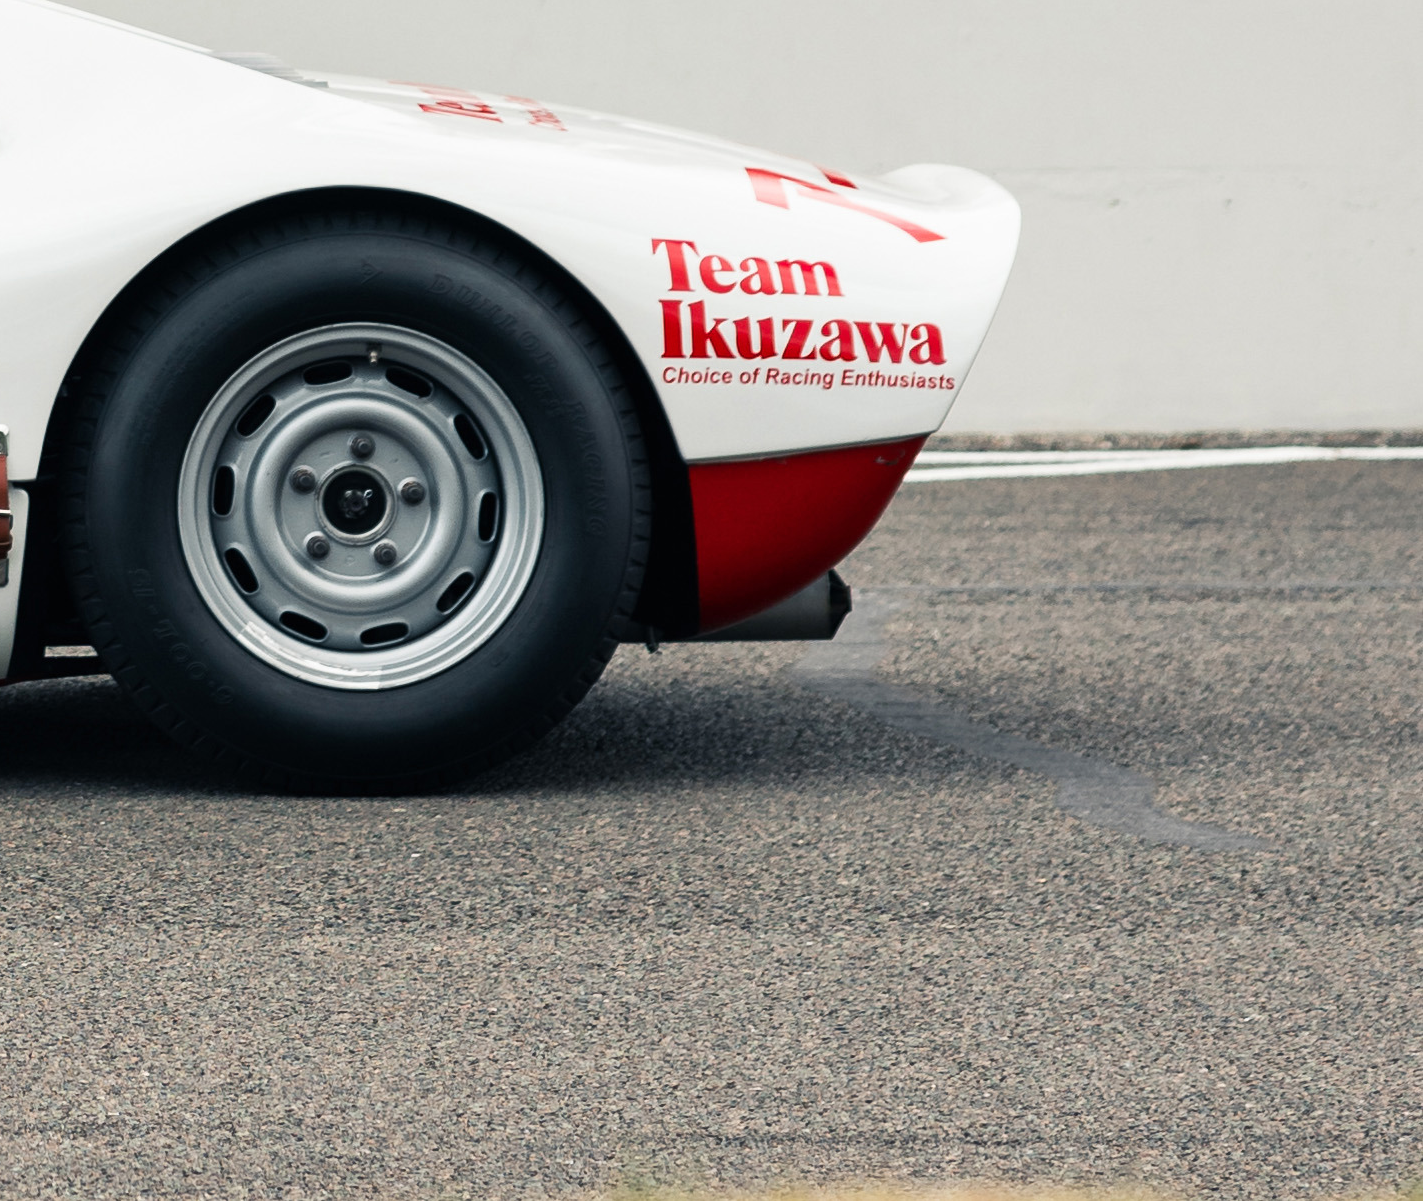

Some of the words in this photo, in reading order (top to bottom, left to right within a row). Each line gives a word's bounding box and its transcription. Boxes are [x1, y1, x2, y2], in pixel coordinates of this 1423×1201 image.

[651, 238, 846, 297] Team
[658, 299, 948, 366] Ikuzawa
[662, 366, 733, 386] Choice
[739, 366, 760, 386] of
[765, 367, 835, 391] Racing
[840, 368, 957, 391] Enthusiasts
